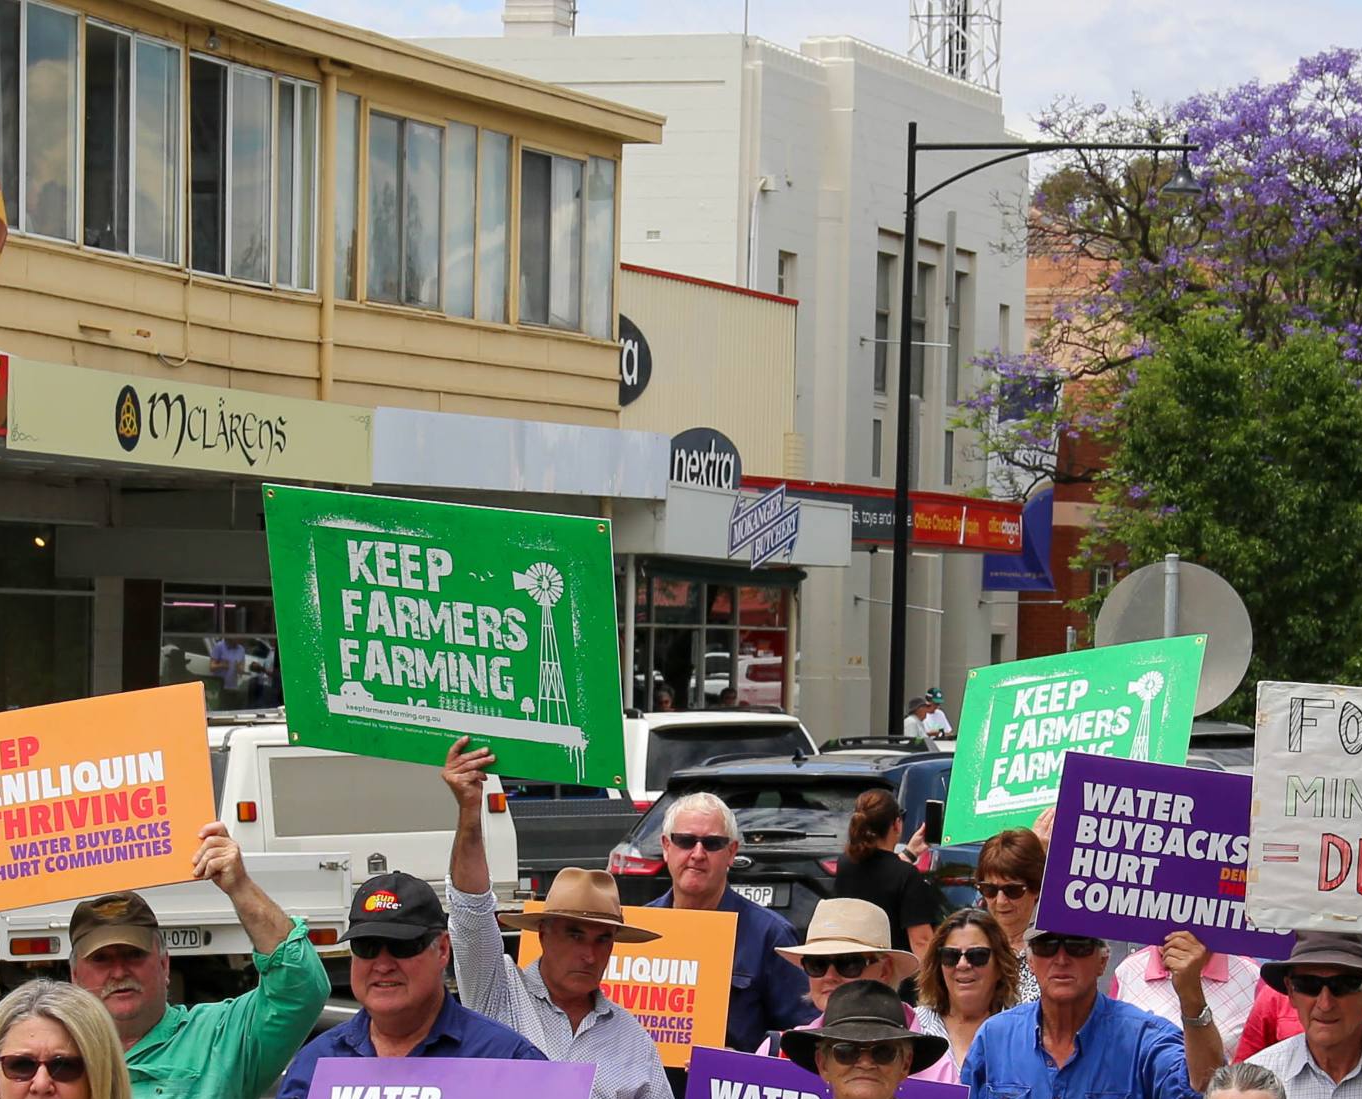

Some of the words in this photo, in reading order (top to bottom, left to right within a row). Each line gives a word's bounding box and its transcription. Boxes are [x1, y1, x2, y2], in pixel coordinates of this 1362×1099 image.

[674, 438, 734, 490] nextra
[732, 491, 784, 546] MOKANGER
[753, 505, 799, 560] BUTCHERY
[862, 511, 878, 527] toys
[346, 539, 453, 592] KEEP
[341, 589, 529, 652] FARMERS
[339, 638, 515, 701] FARMING
[345, 703, 442, 723] keepfarmersfarming.org.au
[1013, 680, 1089, 719] KEEP
[1000, 706, 1132, 753] FARMERS
[1083, 781, 1195, 825] WATER
[9, 835, 71, 861] WATER
[75, 821, 171, 850] BUYBACKS
[44, 838, 173, 874] COMMUNITIES
[1075, 814, 1250, 864] BUYBACKS
[1069, 848, 1161, 886] HURT
[1064, 880, 1294, 935] COMMUNIT
[603, 955, 699, 985] LIQUIN
